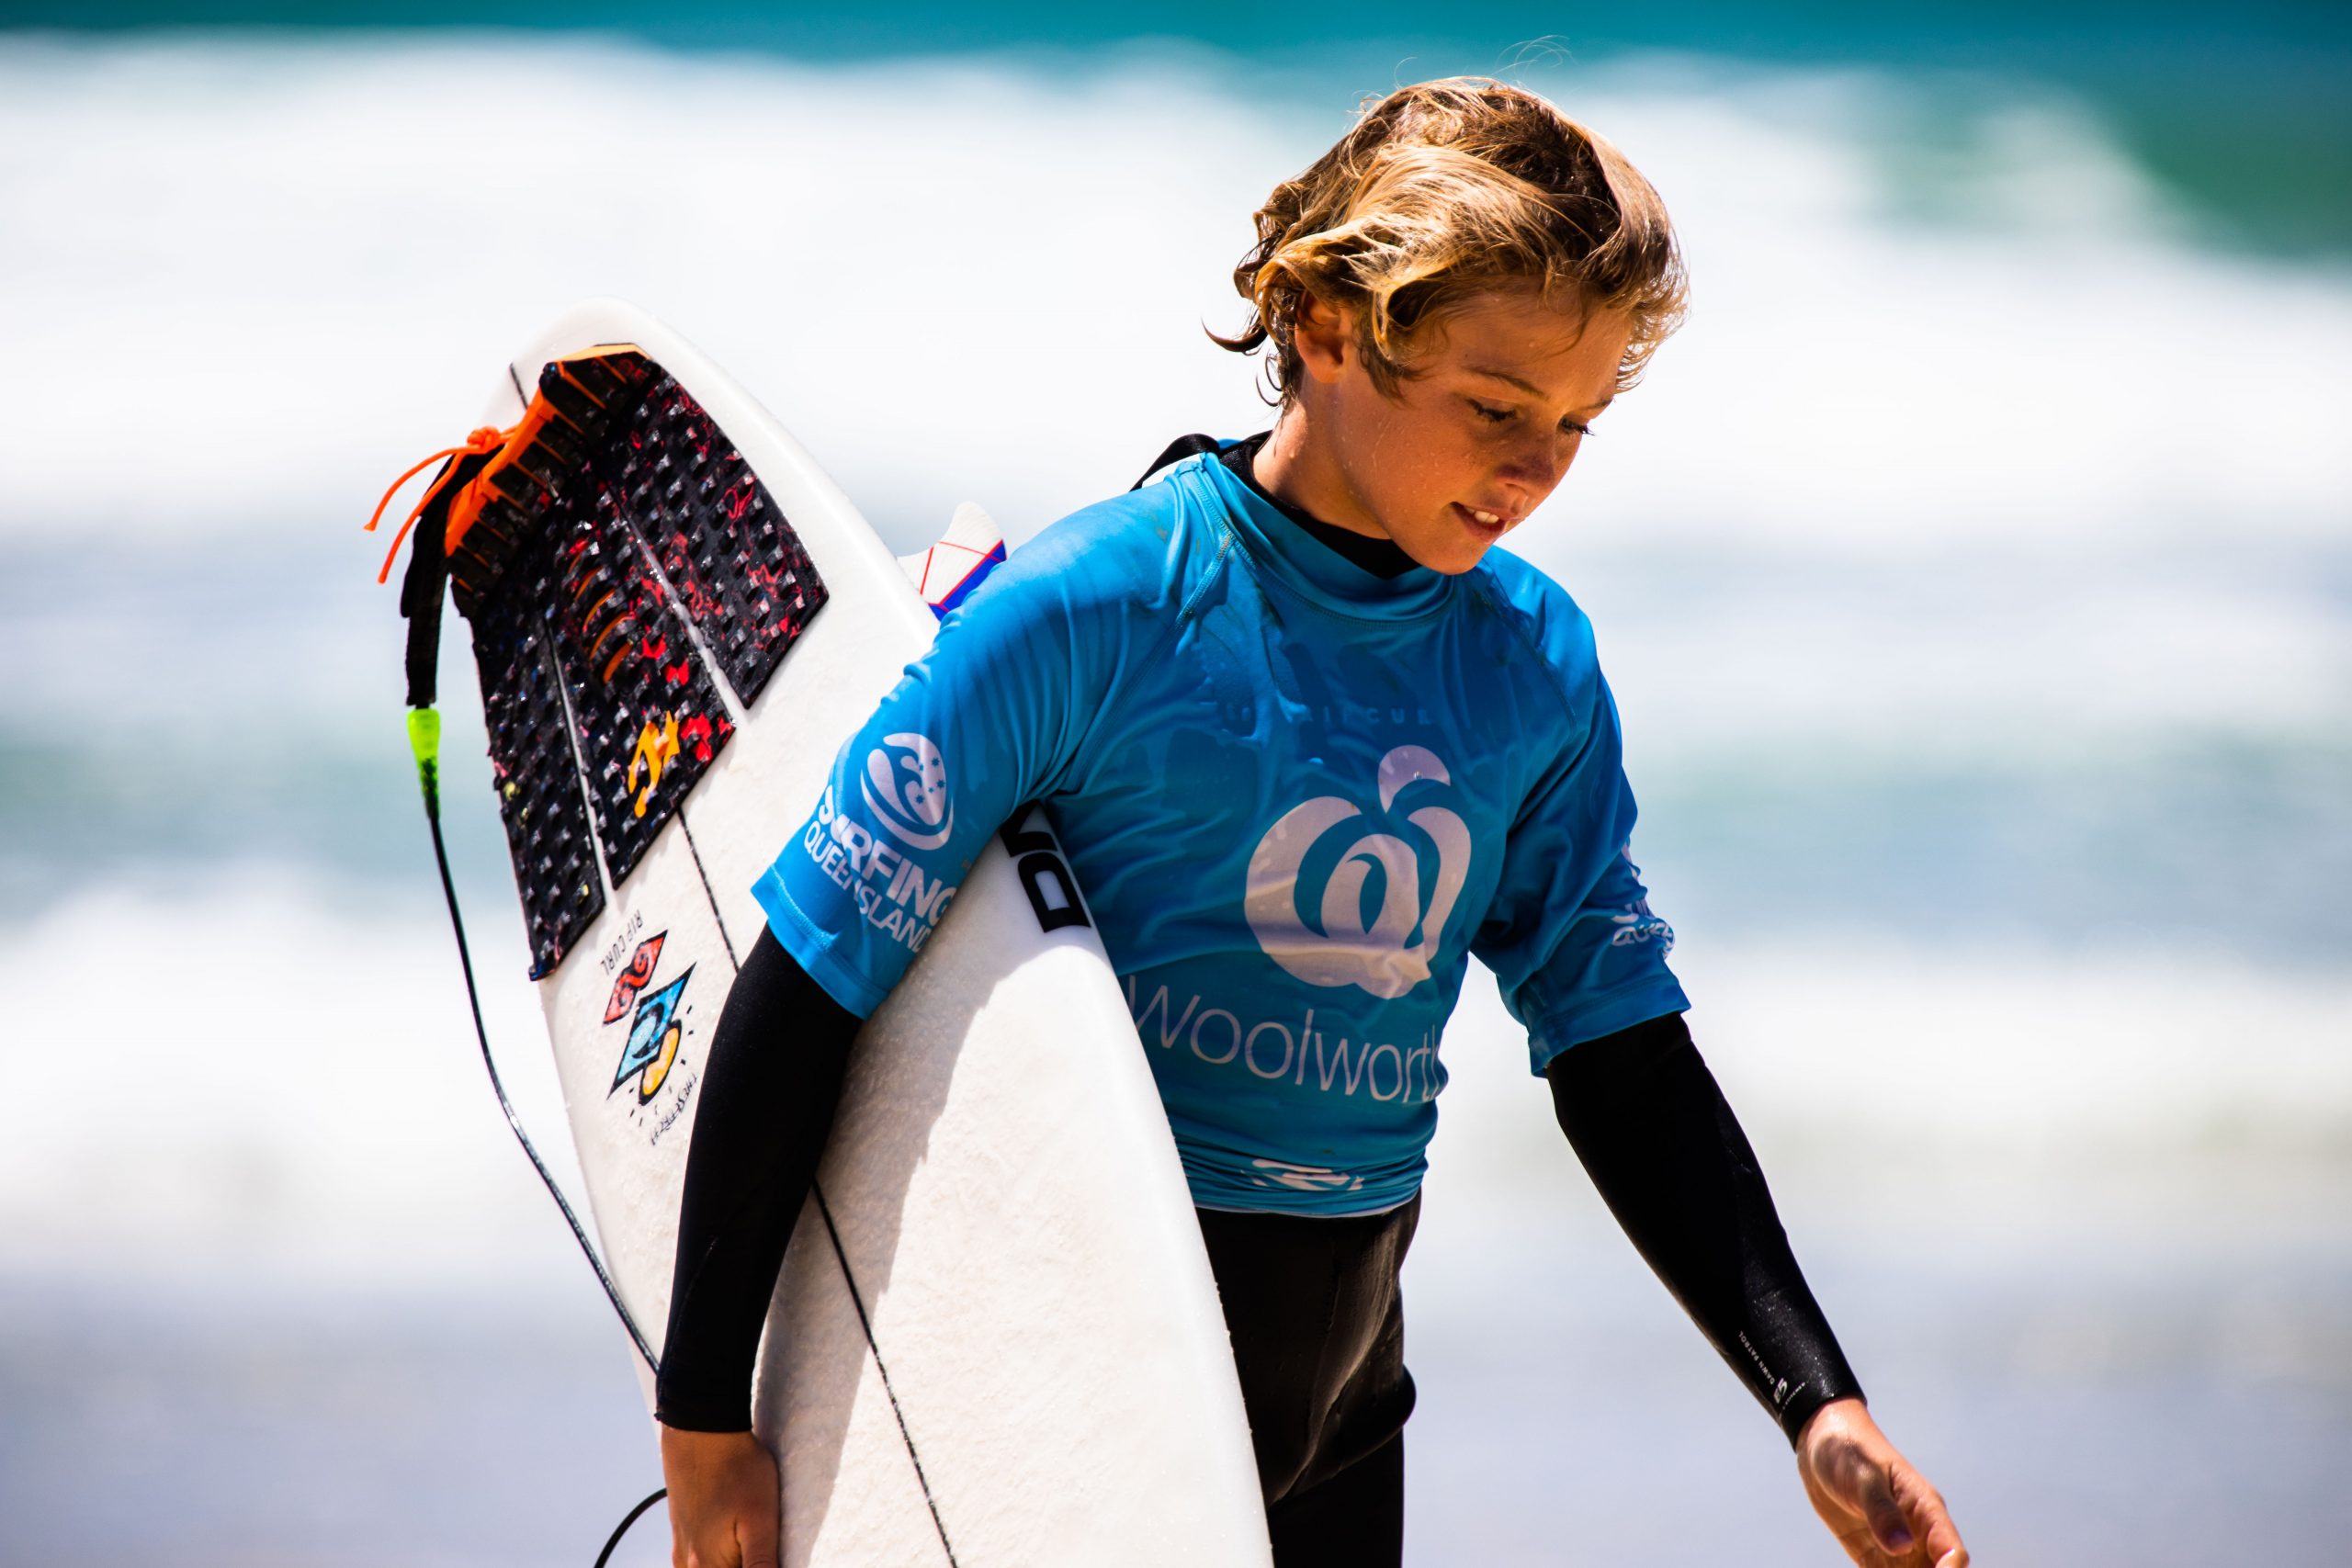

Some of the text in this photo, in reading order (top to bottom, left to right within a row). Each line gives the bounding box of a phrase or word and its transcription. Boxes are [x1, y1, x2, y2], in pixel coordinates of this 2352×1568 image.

[600, 908, 643, 976] RIP CURL
[1738, 1330, 1775, 1385] DAWN PATROL
